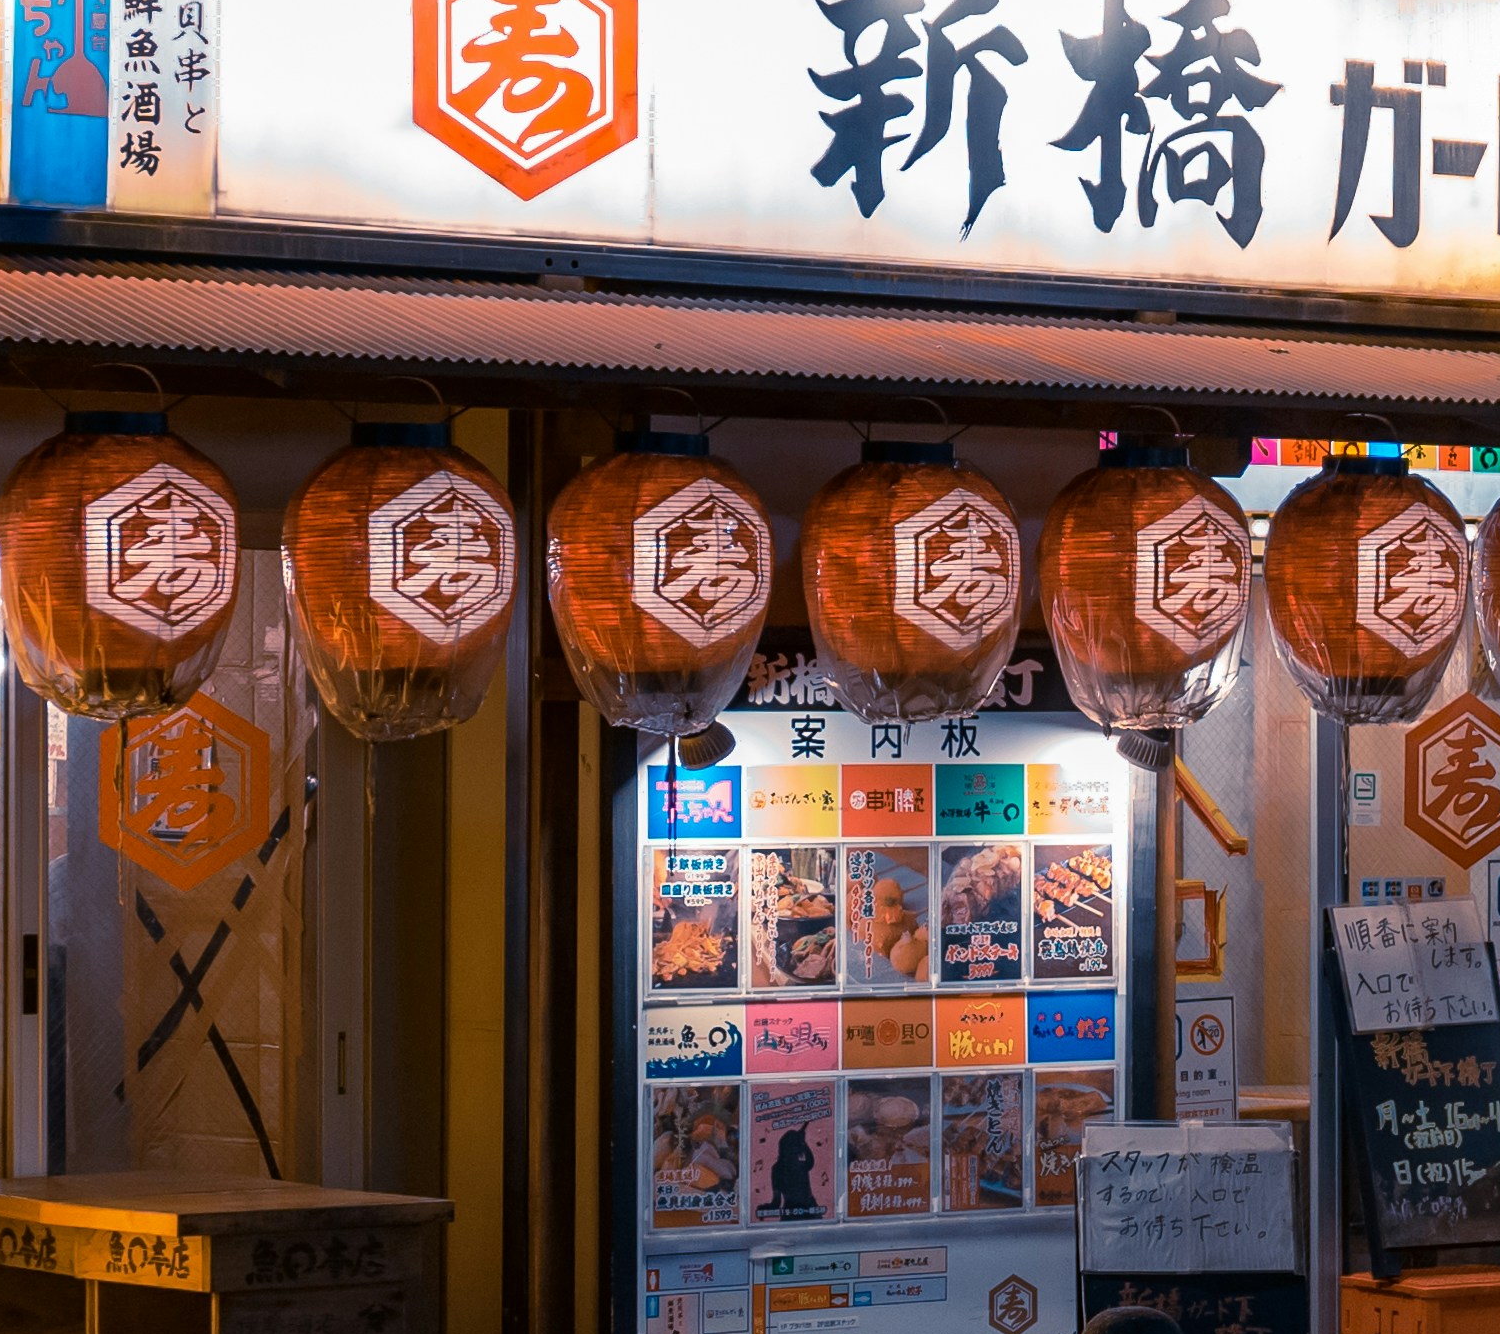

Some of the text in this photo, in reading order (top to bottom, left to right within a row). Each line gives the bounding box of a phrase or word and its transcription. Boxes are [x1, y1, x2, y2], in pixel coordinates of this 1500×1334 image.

[790, 713, 981, 759] 案内板
[1342, 915, 1460, 952] 順番に案内
[1353, 971, 1417, 997] 入口で
[1383, 993, 1495, 1024] お待ち下さい。
[1099, 1150, 1264, 1177] スタッフが検温
